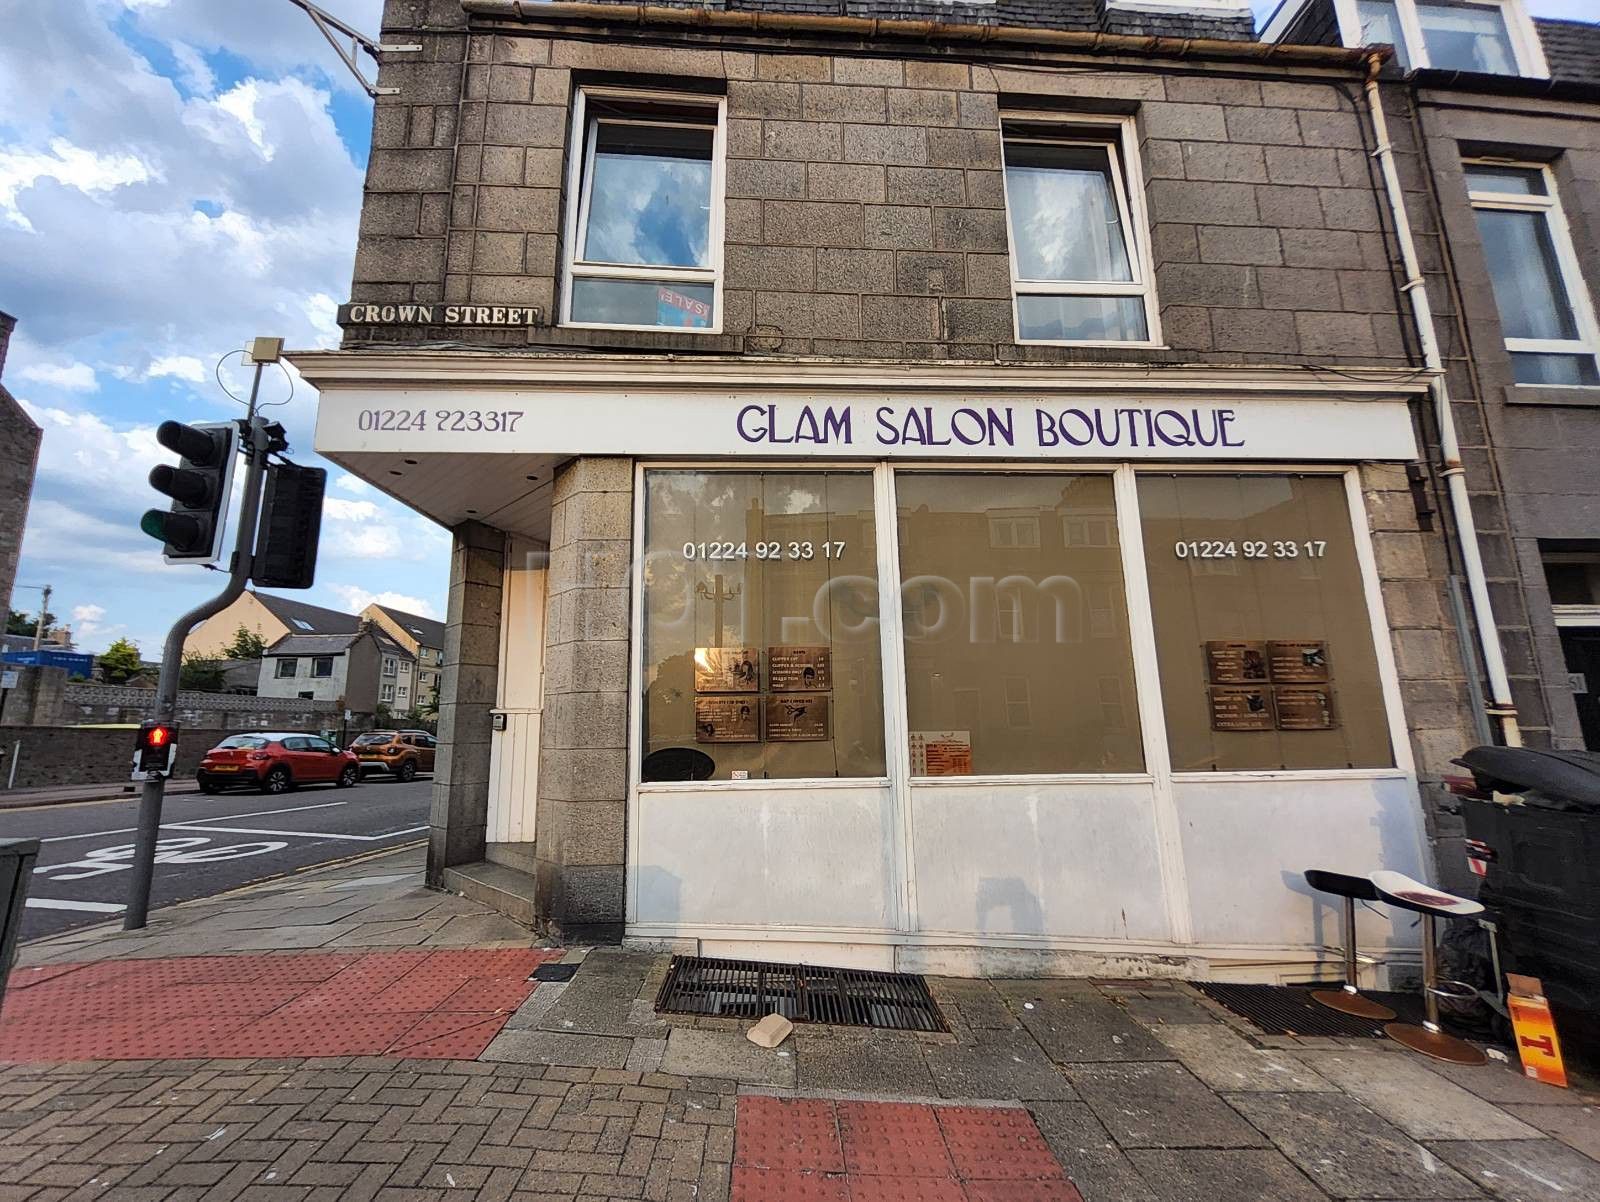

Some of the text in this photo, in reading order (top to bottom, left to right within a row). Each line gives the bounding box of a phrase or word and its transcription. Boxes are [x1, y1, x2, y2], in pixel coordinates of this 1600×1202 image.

[350, 304, 538, 325] CROWN STREET
[358, 409, 525, 433] 01224 923317
[736, 404, 1246, 448] GLAM SALON BOUTIQUE
[682, 541, 846, 559] 01224 92 33 17
[1175, 540, 1327, 558] 01224 92 33 17
